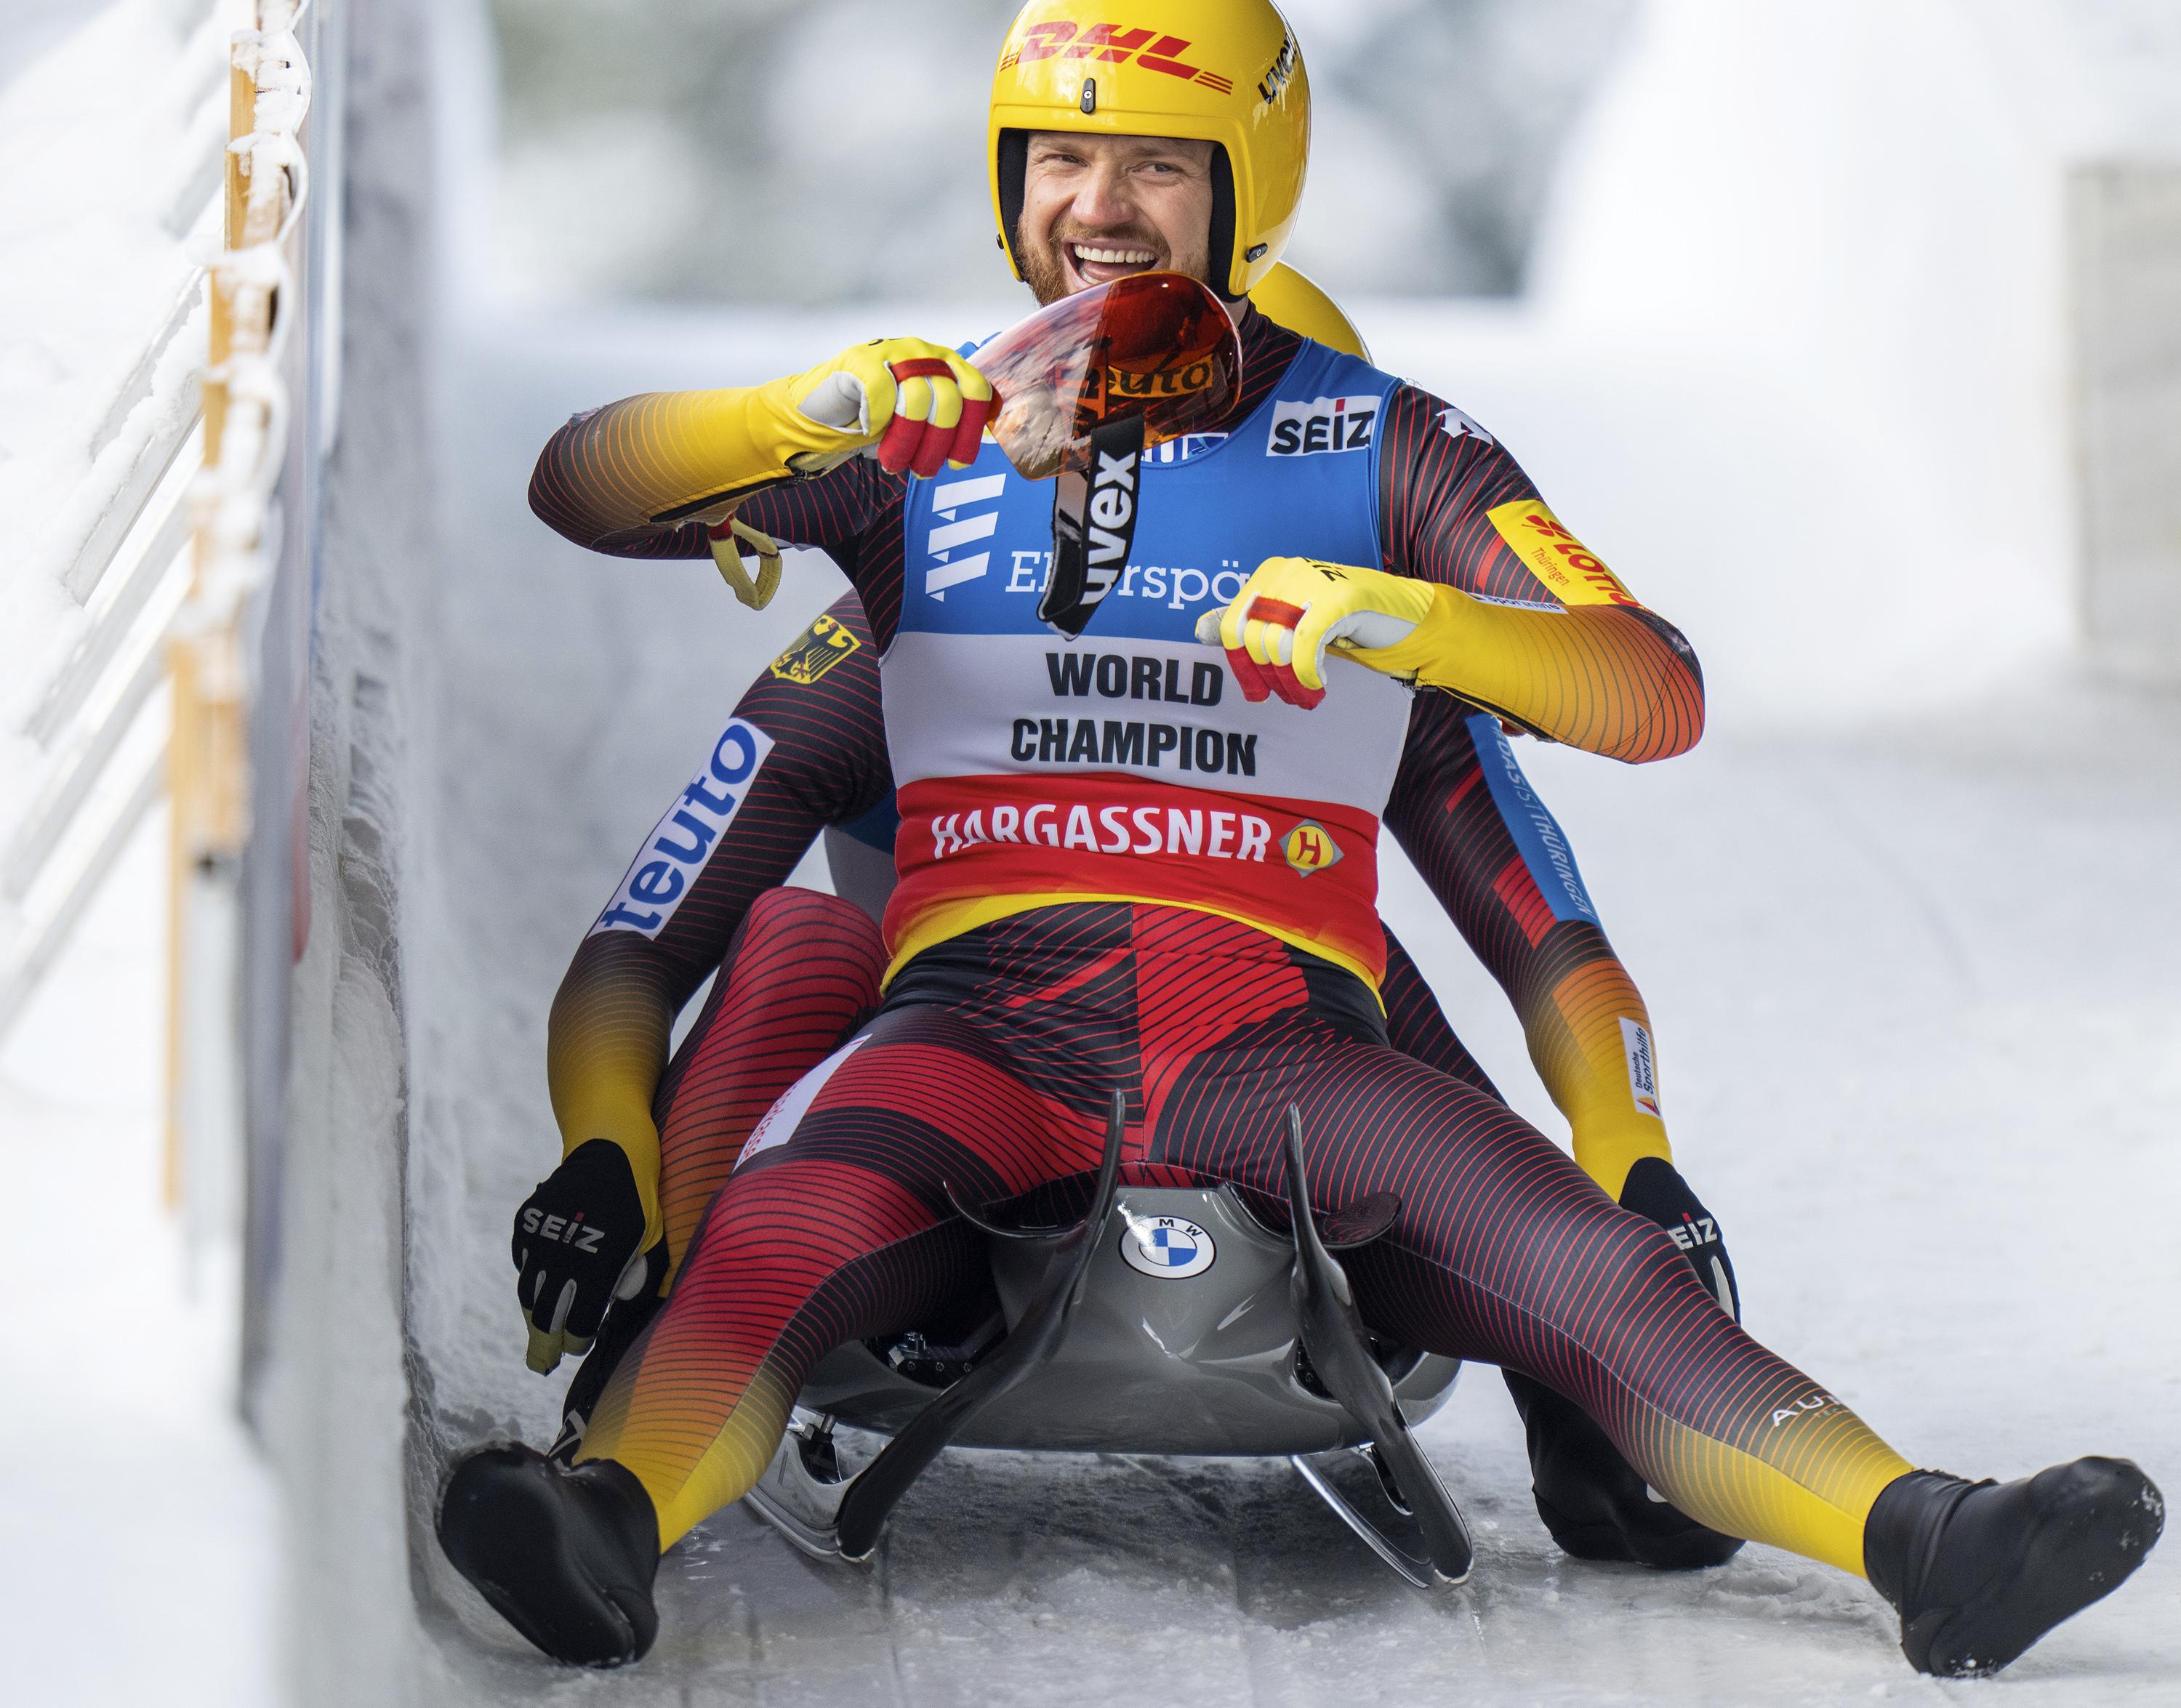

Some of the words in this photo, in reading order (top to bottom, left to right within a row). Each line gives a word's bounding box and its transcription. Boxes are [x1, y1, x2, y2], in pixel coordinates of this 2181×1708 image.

[1016, 20, 1201, 80] DHL
[1079, 450, 1136, 605] uvex
[1530, 547, 1570, 587] Thüringen
[1045, 653, 1224, 707] WORLD
[1011, 718, 1258, 777] CHAMPION
[601, 724, 757, 931] teuto
[931, 803, 1272, 863] HARGASSNER
[1631, 1052, 1643, 1089] Deutsche
[1636, 1027, 1655, 1095] Sporthilfe
[1158, 1217, 1203, 1238] MW
